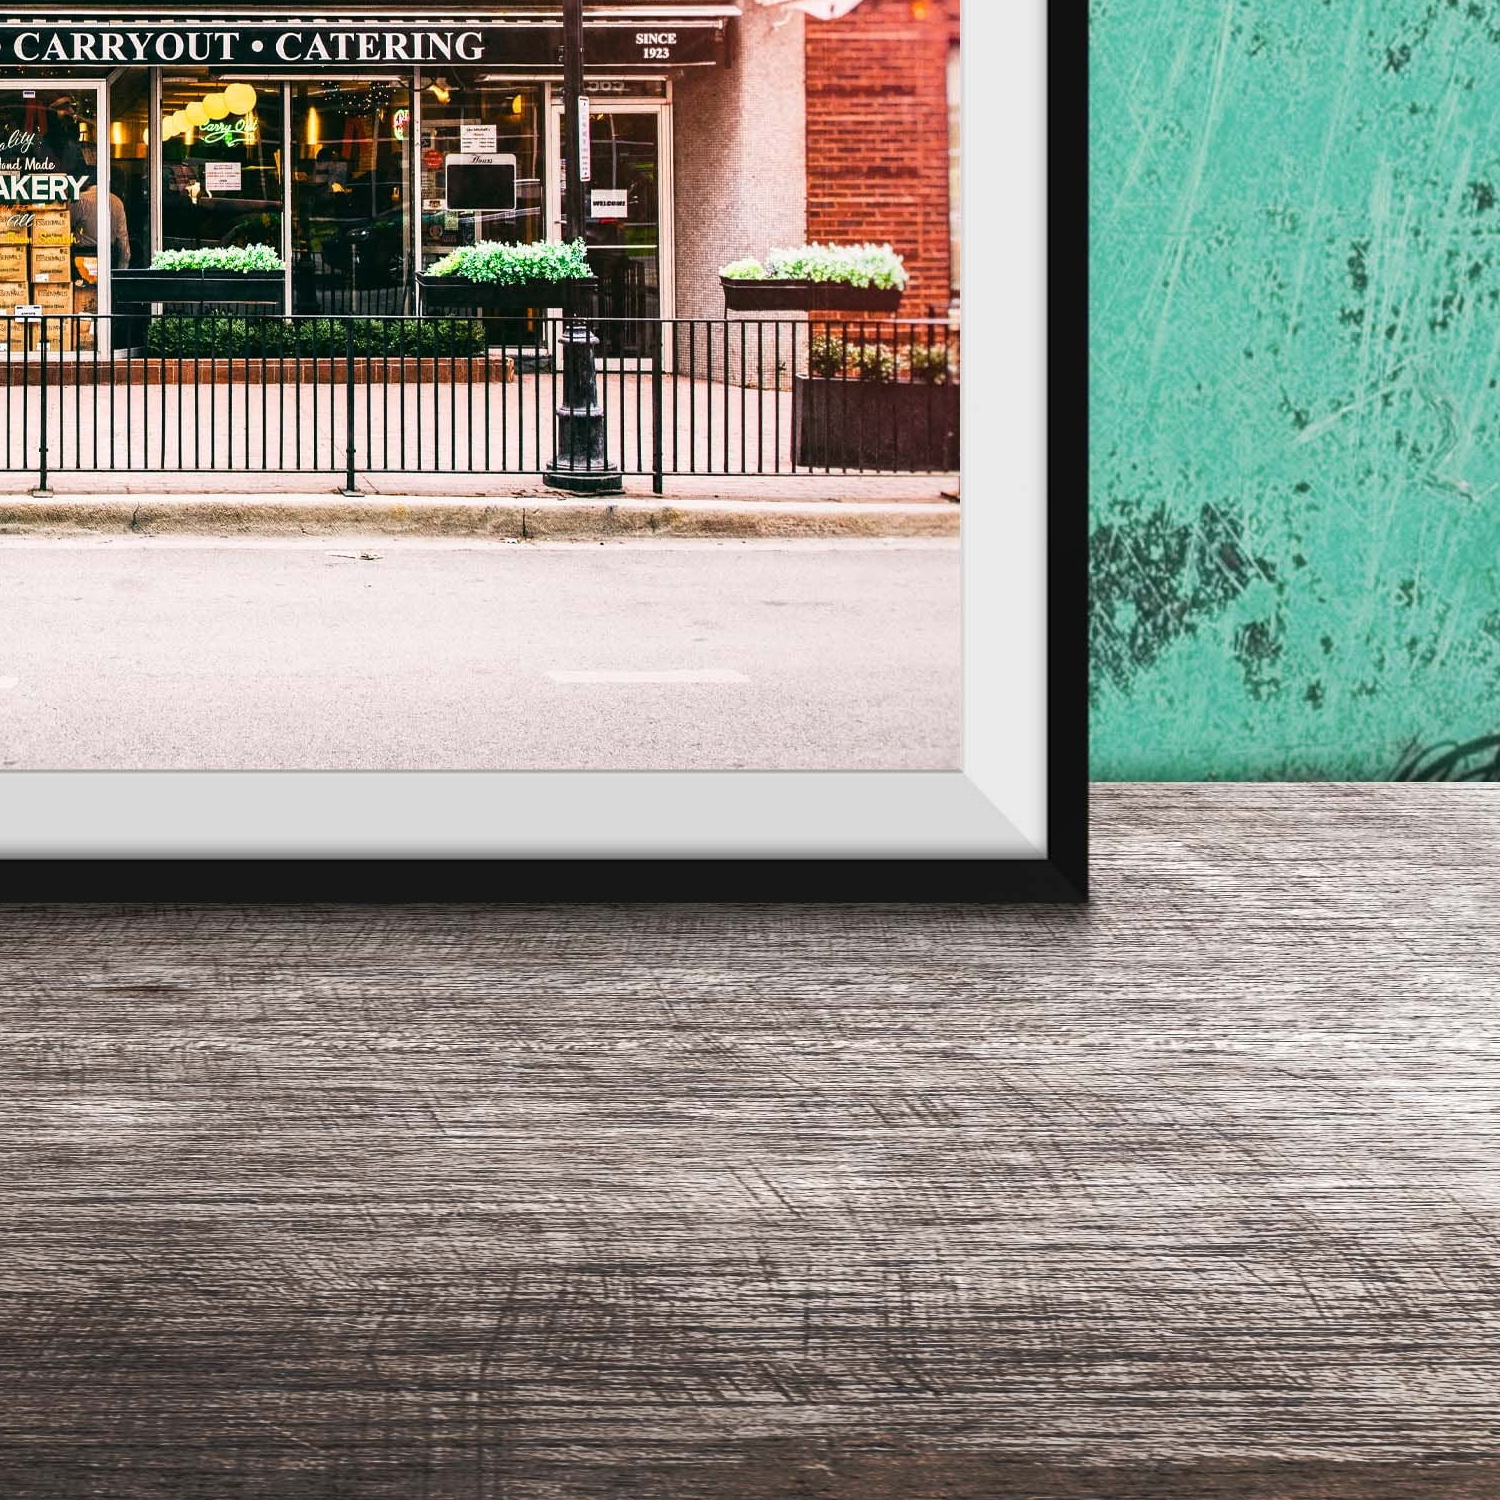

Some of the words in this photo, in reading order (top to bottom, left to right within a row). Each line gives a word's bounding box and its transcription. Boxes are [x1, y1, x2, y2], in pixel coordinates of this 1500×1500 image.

[635, 32, 677, 45] SINCE
[13, 31, 239, 63] CARRYOUT
[274, 32, 486, 63] CATERING
[643, 47, 670, 59] 1923
[24, 156, 56, 171] Made
